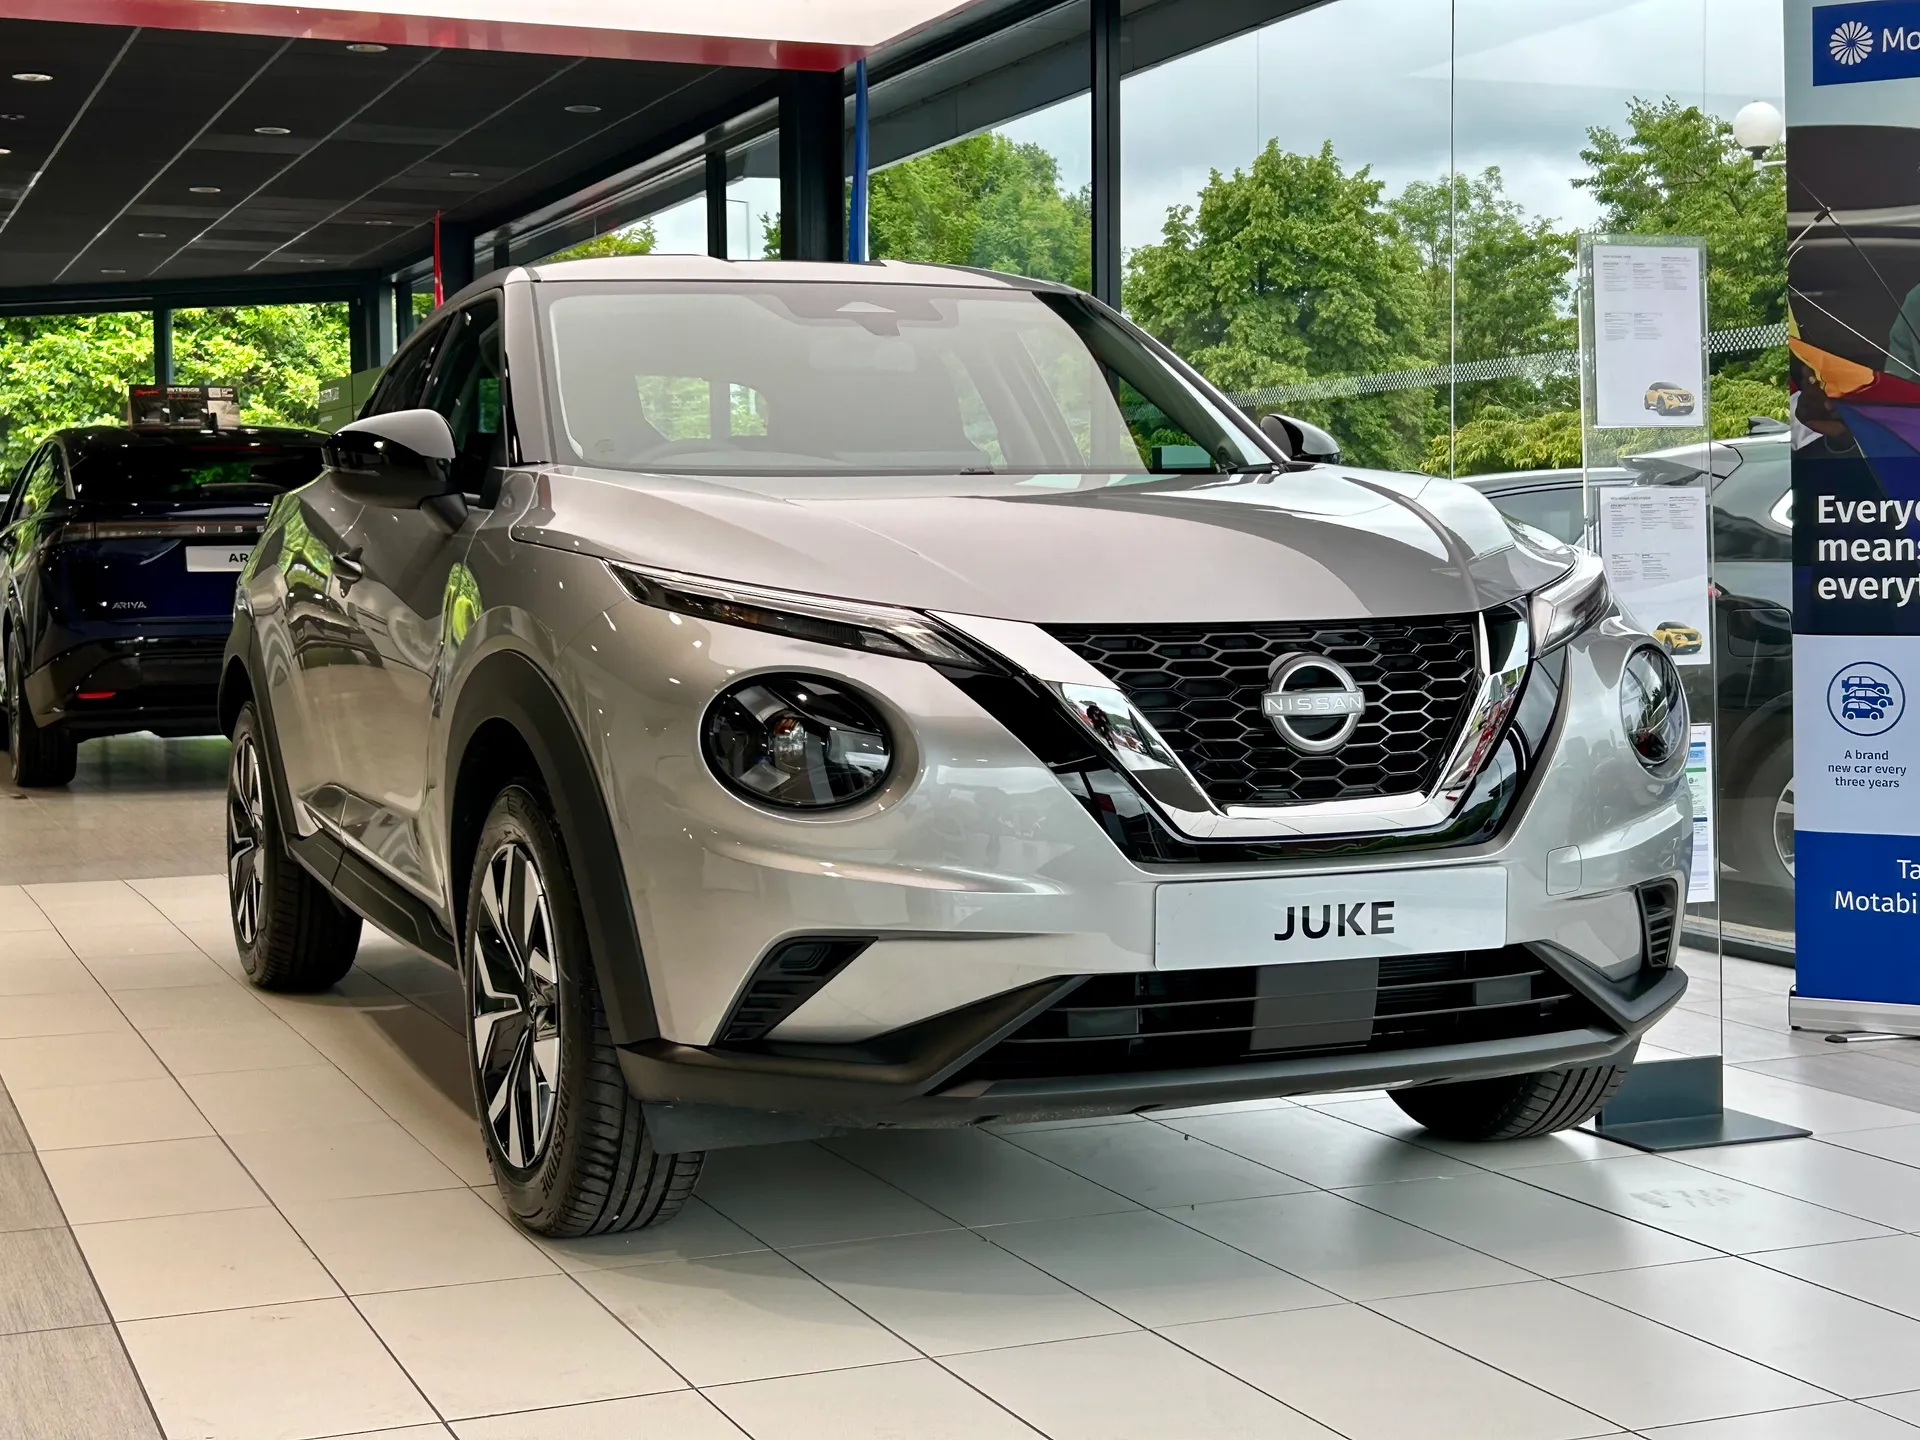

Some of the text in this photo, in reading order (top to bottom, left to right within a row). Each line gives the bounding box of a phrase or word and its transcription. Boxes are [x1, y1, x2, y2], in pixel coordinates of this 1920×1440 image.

[1882, 27, 1920, 53] Mo
[1818, 494, 1920, 530] Every
[1818, 538, 1920, 562] mean
[112, 601, 147, 609] ARIYA
[1267, 696, 1362, 711] NISSAN
[1844, 749, 1889, 760] A brand
[1828, 764, 1907, 777] new car every
[1835, 776, 1900, 789] three years
[1896, 859, 1920, 880] Ta
[1835, 890, 1917, 914] Motabi
[1274, 901, 1395, 941] JUKE
